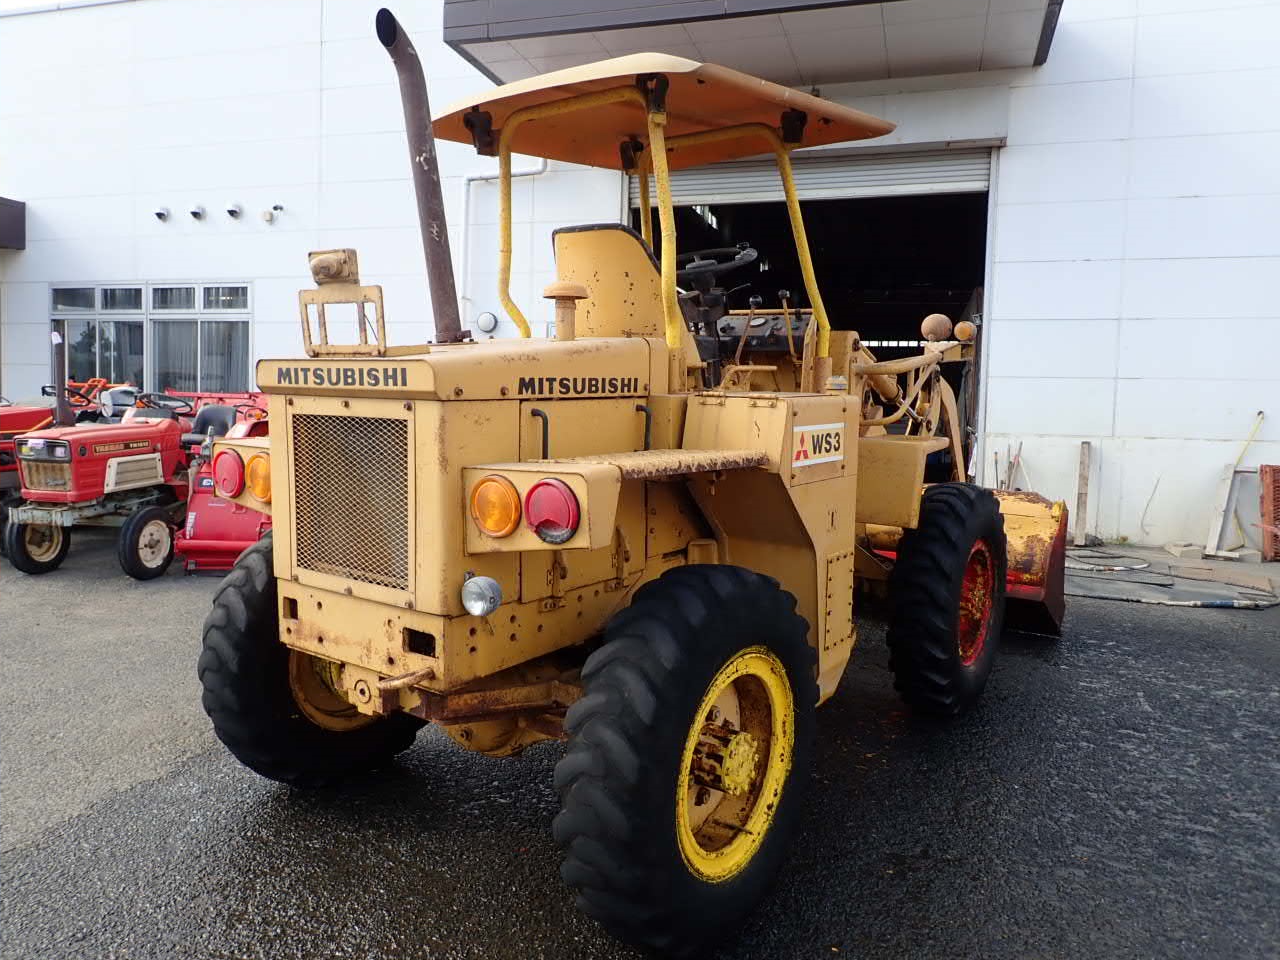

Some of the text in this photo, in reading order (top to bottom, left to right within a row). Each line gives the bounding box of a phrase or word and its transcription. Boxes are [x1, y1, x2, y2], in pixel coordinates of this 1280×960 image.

[277, 367, 408, 387] MITSUBISHI
[517, 377, 639, 395] MITSUBISHI
[811, 432, 841, 455] WS3
